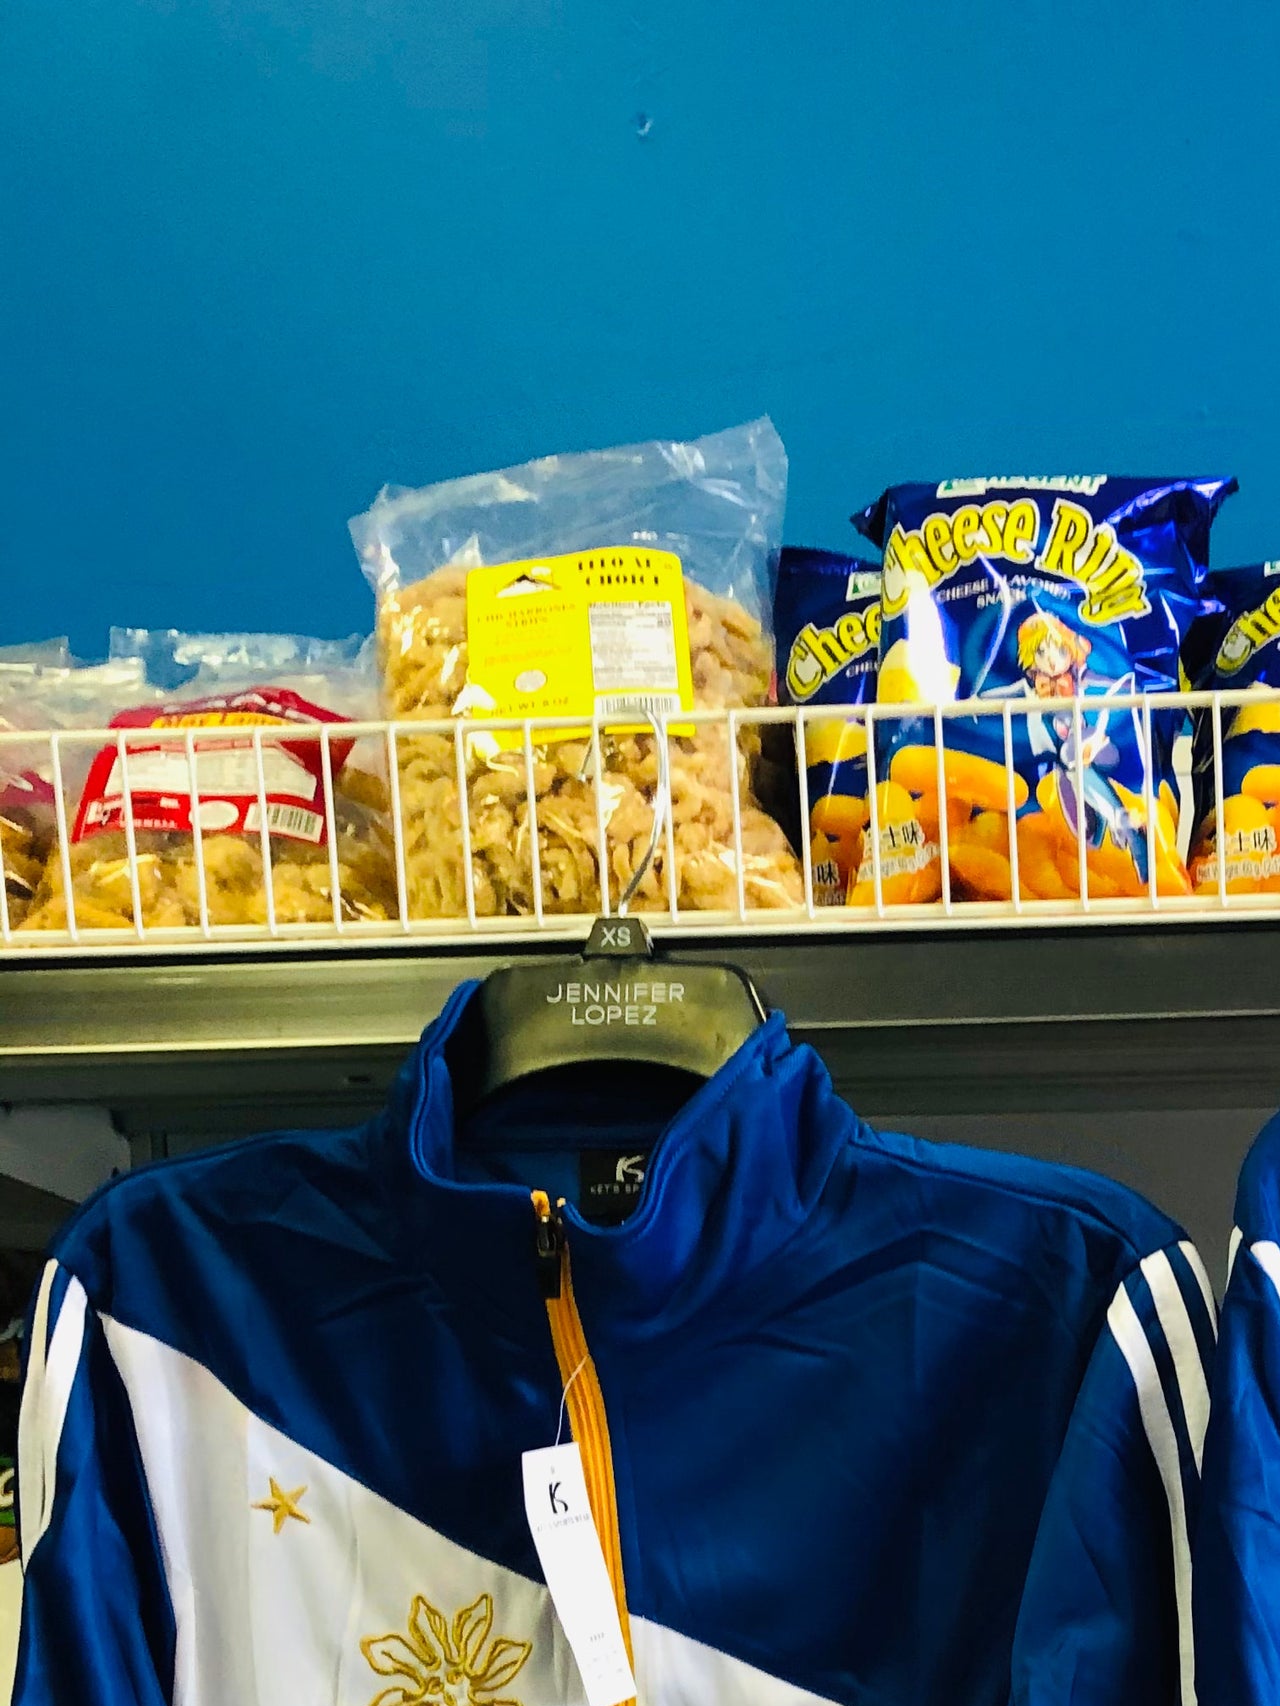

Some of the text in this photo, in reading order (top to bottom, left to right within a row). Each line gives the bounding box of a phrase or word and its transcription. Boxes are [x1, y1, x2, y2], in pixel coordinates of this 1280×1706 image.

[881, 499, 1040, 622] Cheese
[786, 601, 881, 702] Chee
[600, 926, 631, 947] XS
[546, 983, 685, 1004] JENNIFER
[571, 1005, 657, 1025] LOPEZ
